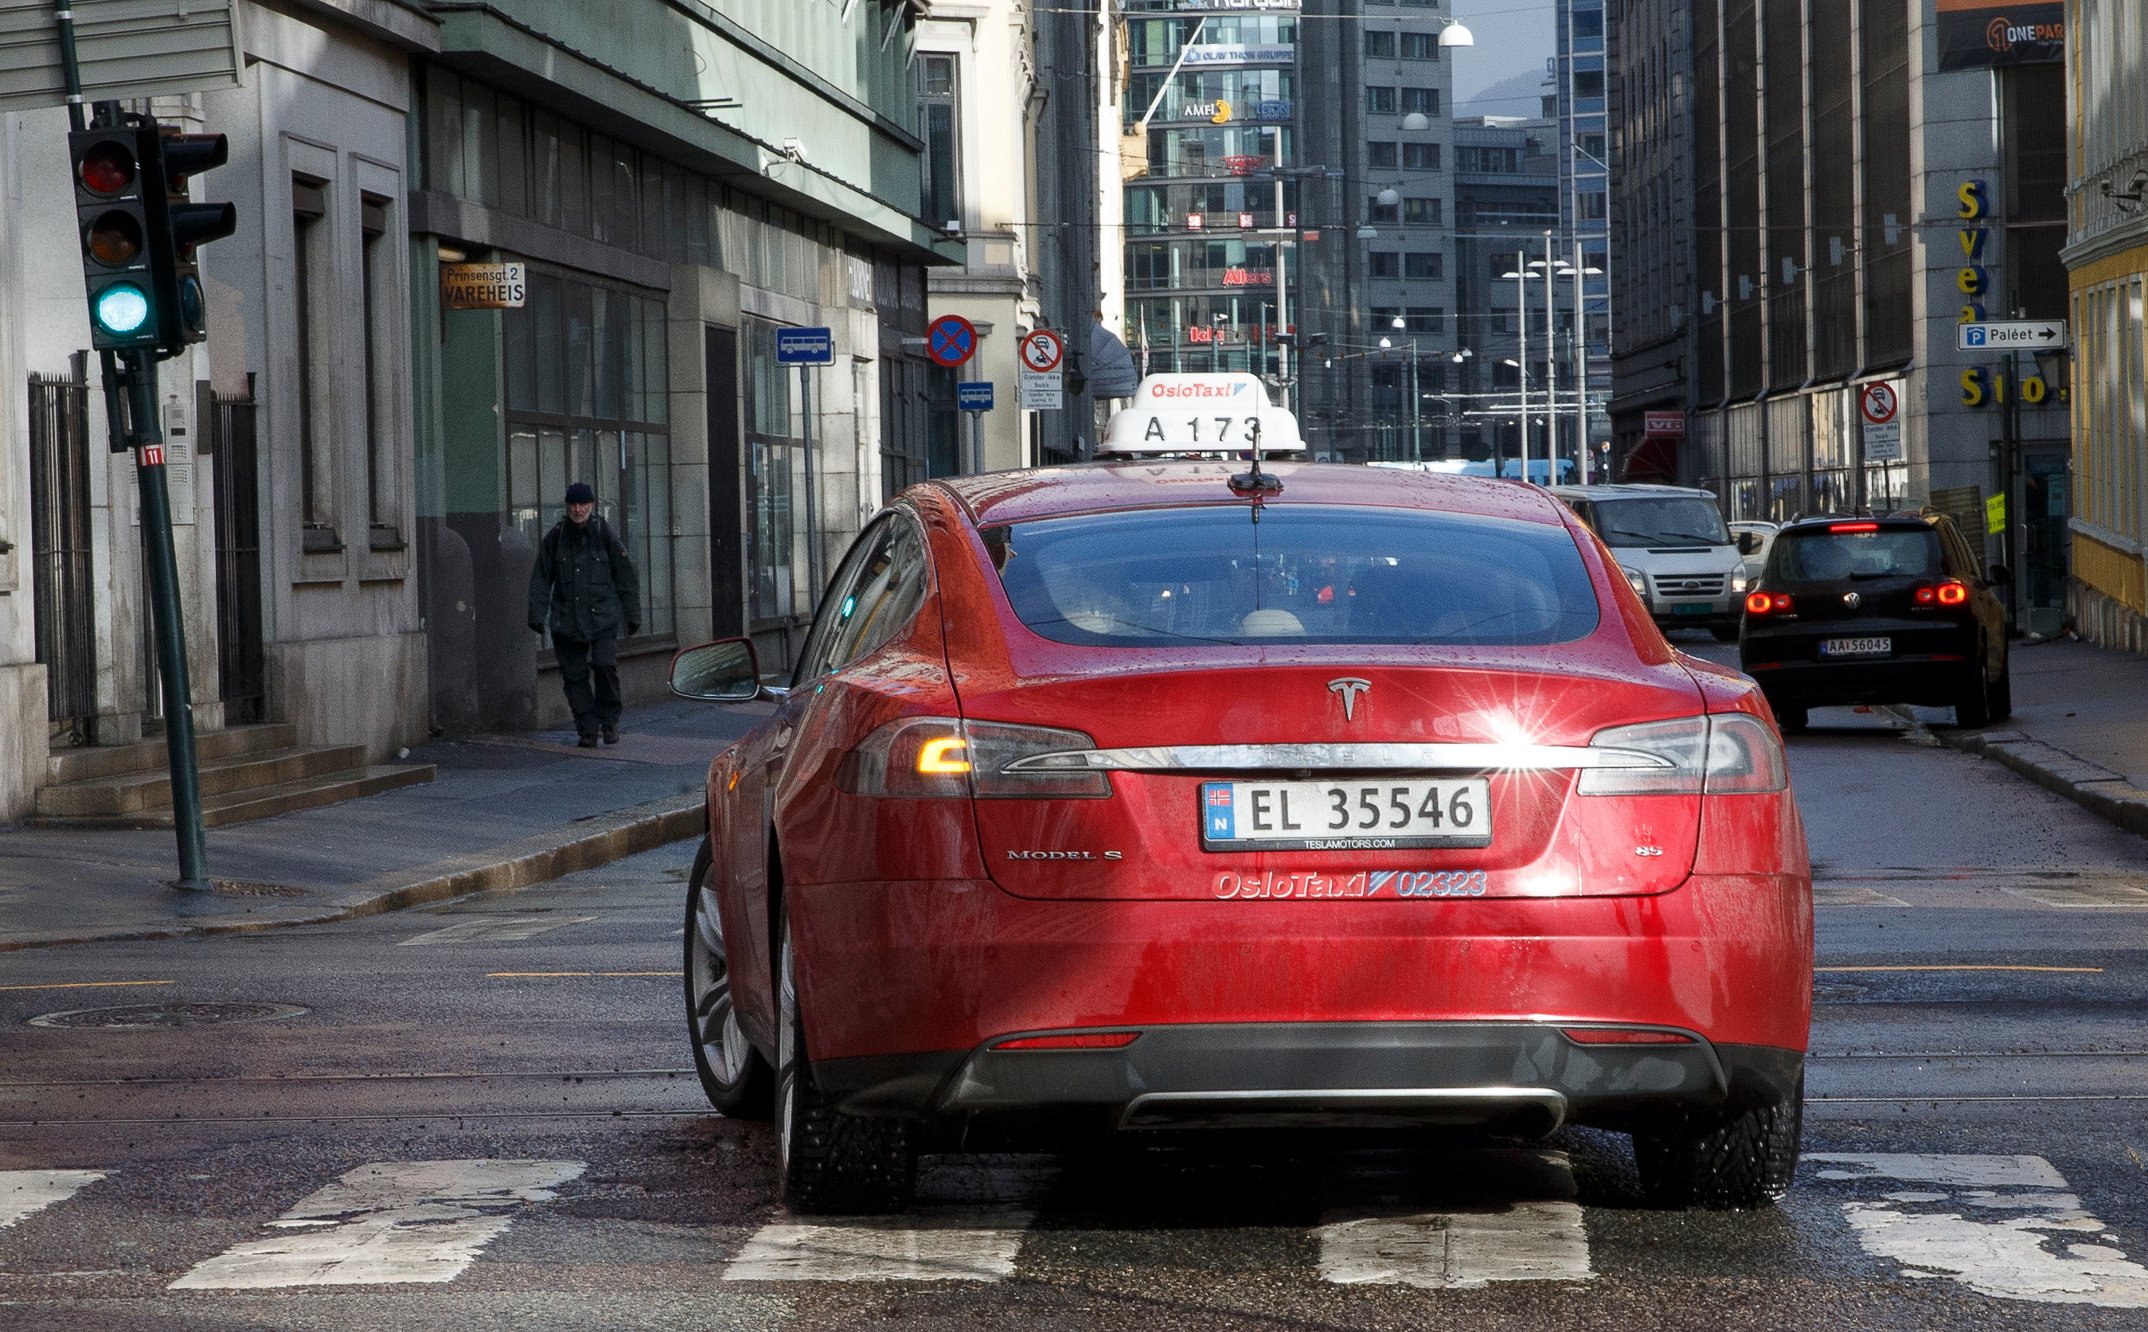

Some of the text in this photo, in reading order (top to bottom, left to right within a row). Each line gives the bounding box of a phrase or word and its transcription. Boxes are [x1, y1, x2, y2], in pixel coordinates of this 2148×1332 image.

[1223, 268, 1272, 285] Allers
[444, 284, 524, 303] VAREHEIS
[1990, 329, 2033, 341] Paléet
[1152, 383, 1232, 398] OsloTaxi
[1144, 416, 1165, 441] A
[147, 449, 159, 464] 11
[1250, 785, 1475, 831] EL 35546
[1214, 817, 1228, 831] N
[1304, 839, 1396, 849] TESLAMOTORS.COM
[1104, 850, 1124, 860] S
[1211, 869, 1488, 899] OsloTaxi 02323
